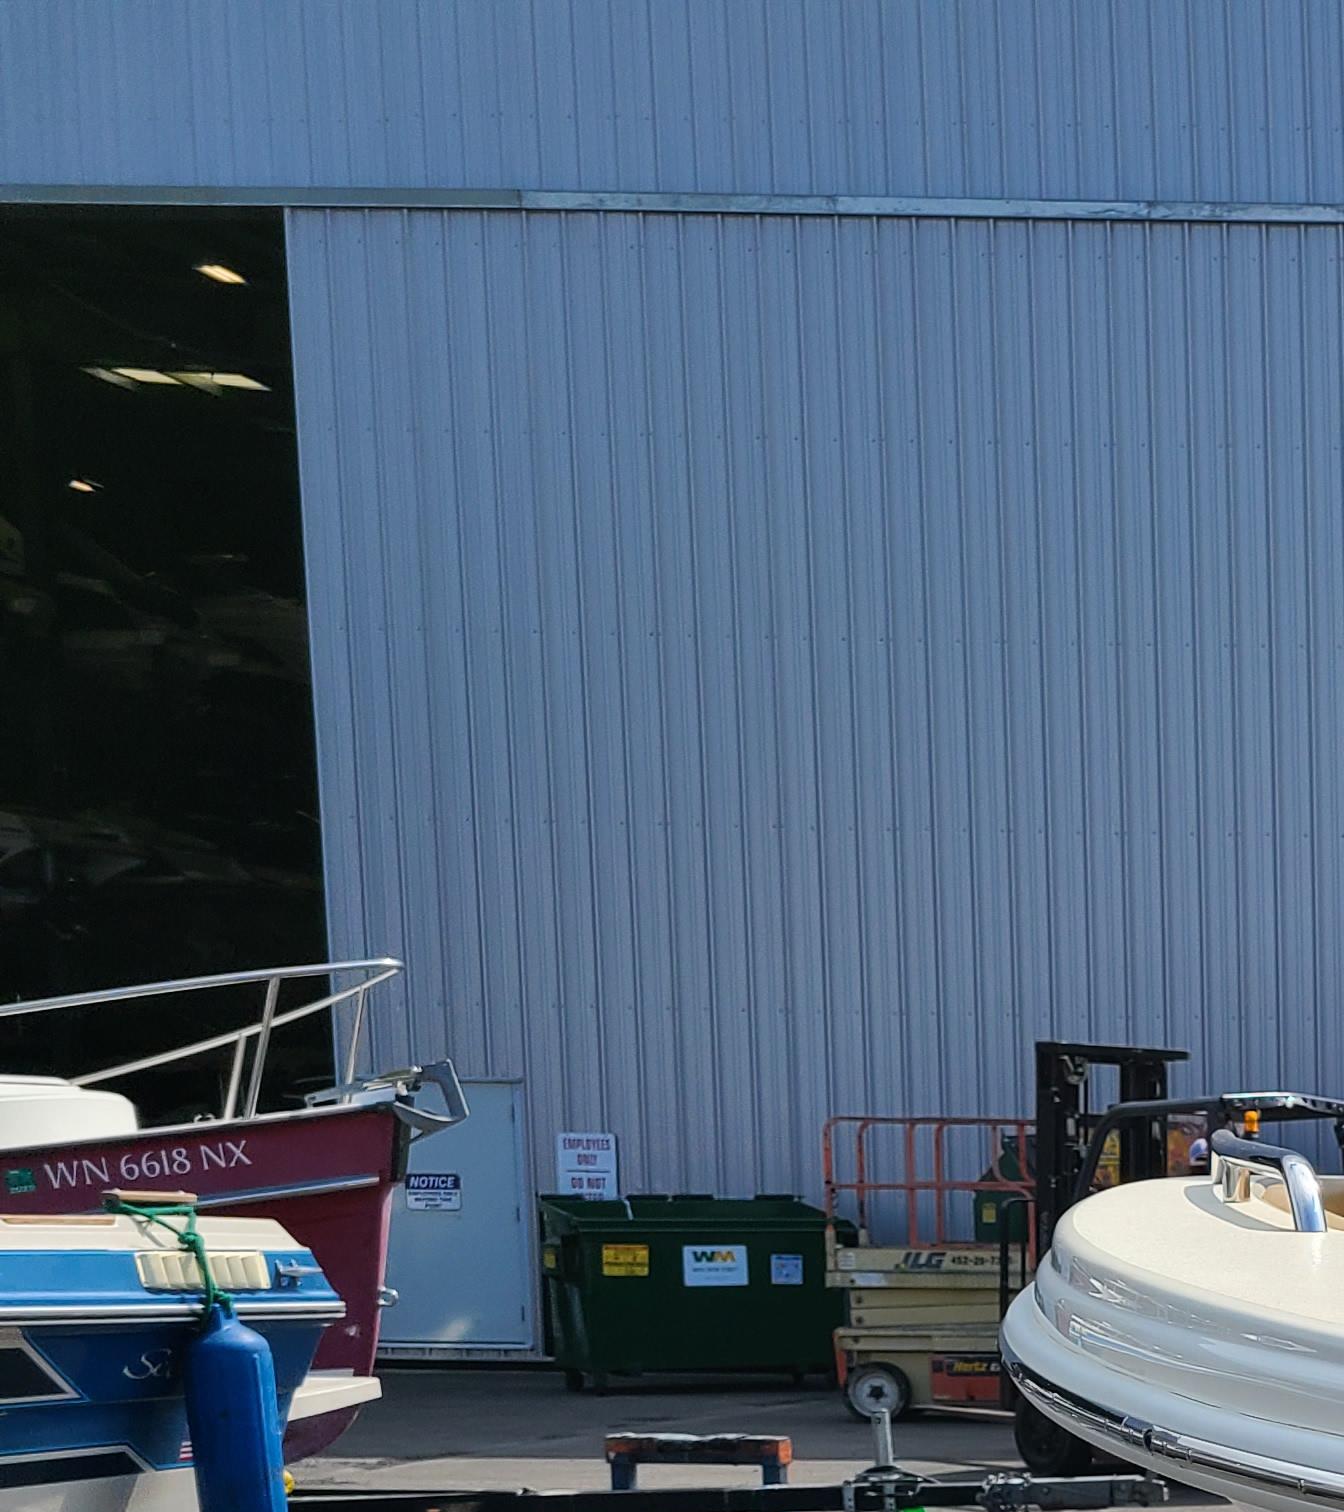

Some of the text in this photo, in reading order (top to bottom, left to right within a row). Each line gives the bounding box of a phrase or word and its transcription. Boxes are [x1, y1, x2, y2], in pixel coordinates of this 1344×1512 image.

[562, 1138, 611, 1151] EMPLOYEES
[44, 1139, 253, 1189] WN 6618 NX
[409, 1175, 456, 1189] NOTICE
[571, 1177, 607, 1190] DO NOT
[692, 1250, 737, 1263] WM
[895, 1251, 947, 1270] JLG
[953, 1361, 988, 1373] Hertz
